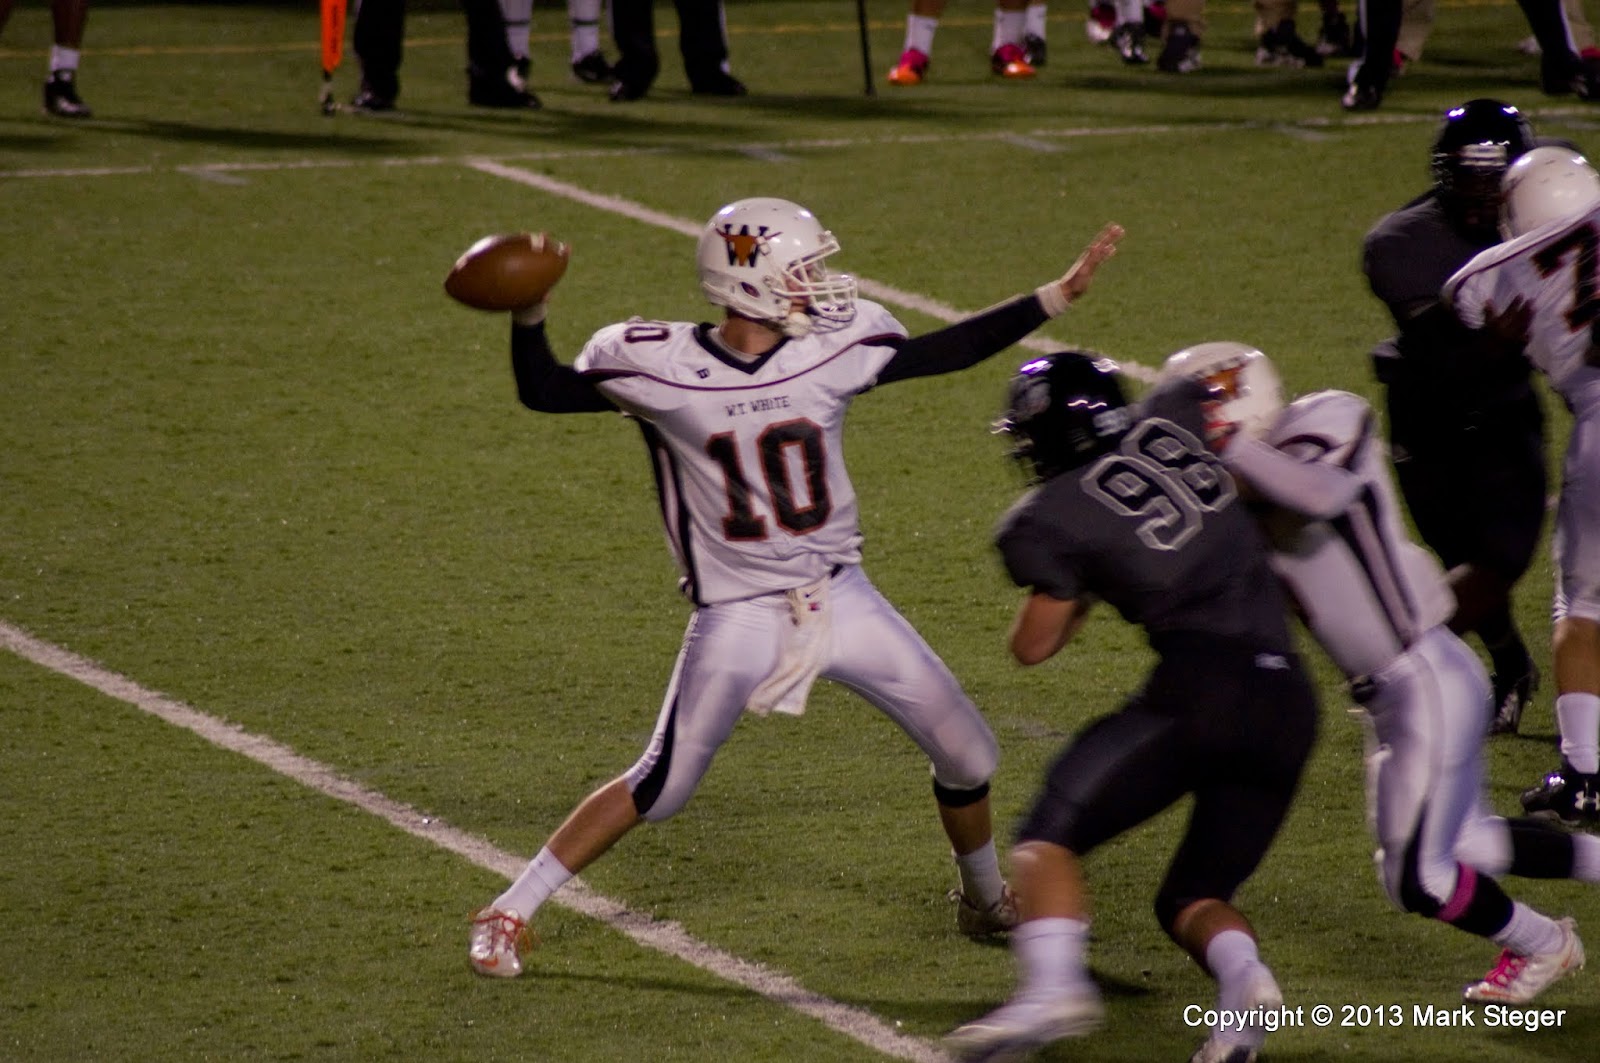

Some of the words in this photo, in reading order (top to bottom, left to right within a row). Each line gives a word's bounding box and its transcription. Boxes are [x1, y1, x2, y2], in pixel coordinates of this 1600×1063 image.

[749, 395, 792, 412] WHITE
[704, 417, 834, 542] 10
[1079, 416, 1238, 551] 98
